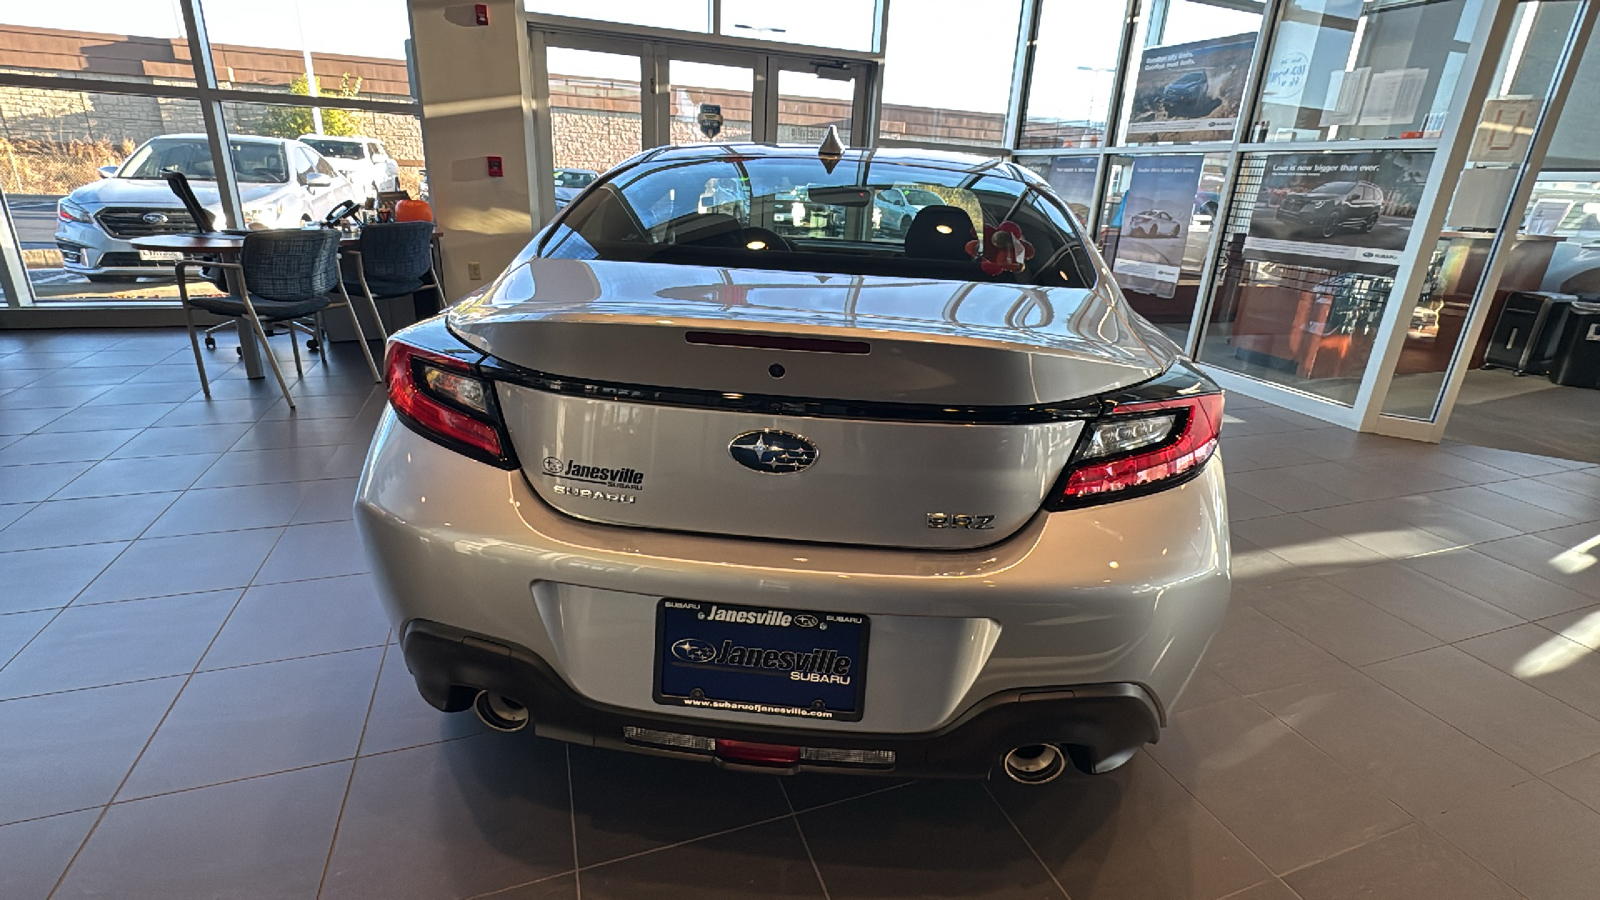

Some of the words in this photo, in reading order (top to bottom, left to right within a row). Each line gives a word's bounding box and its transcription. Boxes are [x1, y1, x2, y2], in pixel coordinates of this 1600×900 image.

[1313, 164, 1339, 173] bigger
[1340, 163, 1357, 172] than
[565, 459, 644, 484] Janesville
[553, 484, 636, 504] SUBARU
[606, 481, 643, 490] SUBARU
[926, 512, 997, 530] BRZ
[664, 601, 701, 609] SUBARU
[707, 605, 792, 627] Janesville
[826, 615, 863, 624] SUBARU
[715, 640, 851, 675] Janesville
[789, 671, 851, 685] SUBARU
[683, 699, 833, 718] www.subaruofjanesville.com
